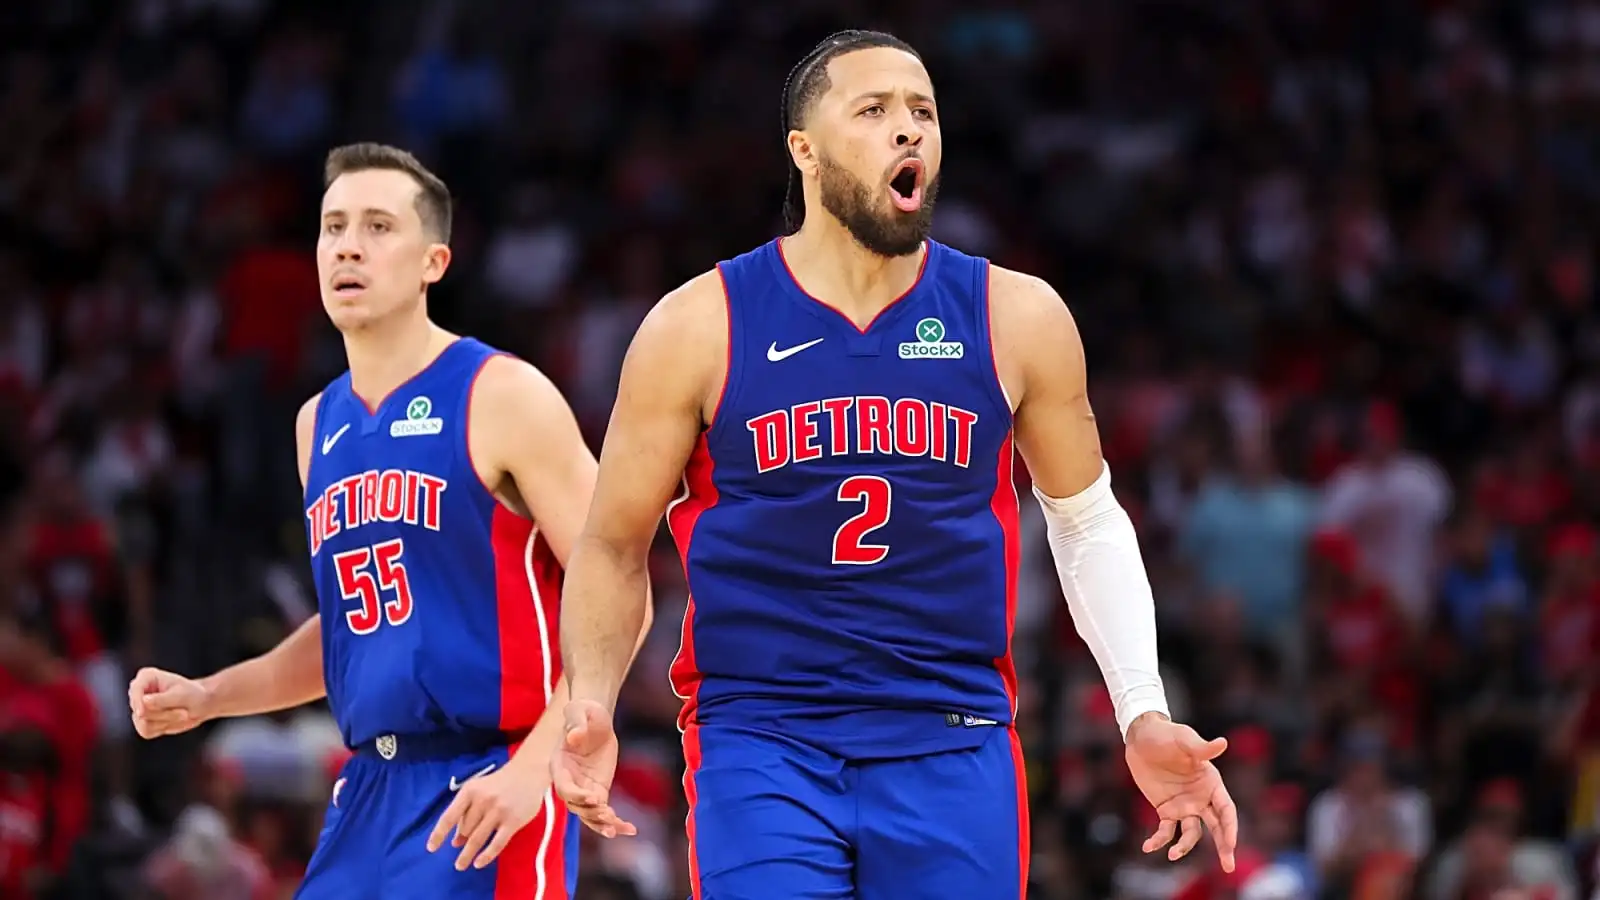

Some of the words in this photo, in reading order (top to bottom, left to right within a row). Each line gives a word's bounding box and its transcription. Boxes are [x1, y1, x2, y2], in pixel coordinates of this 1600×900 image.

[901, 344, 961, 356] StockX
[746, 395, 978, 474] DETROIT
[306, 469, 448, 557] DETROIT
[832, 475, 892, 565] 2
[333, 538, 413, 635] 55
